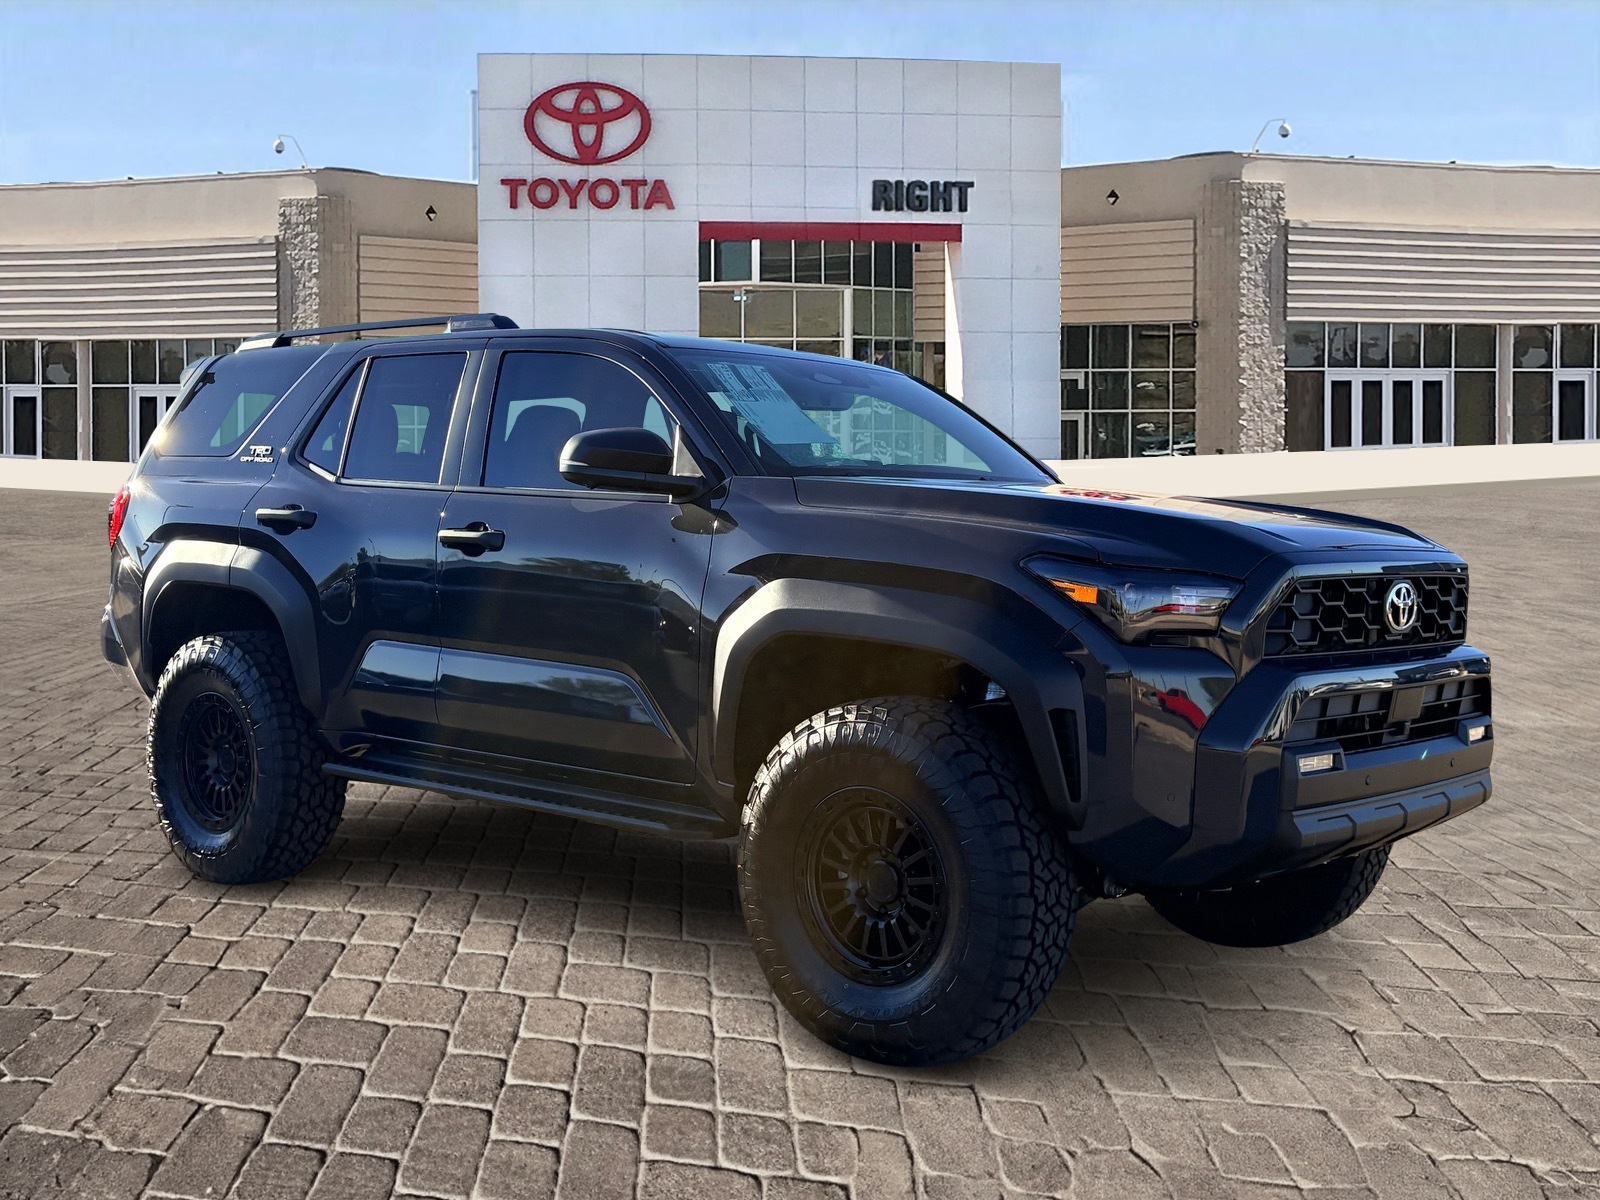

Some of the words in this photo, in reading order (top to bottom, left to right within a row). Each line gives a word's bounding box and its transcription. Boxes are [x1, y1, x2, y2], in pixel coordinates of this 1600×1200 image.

[500, 178, 675, 210] TOYOTA
[871, 179, 975, 213] RIGHT
[249, 446, 272, 457] TRD
